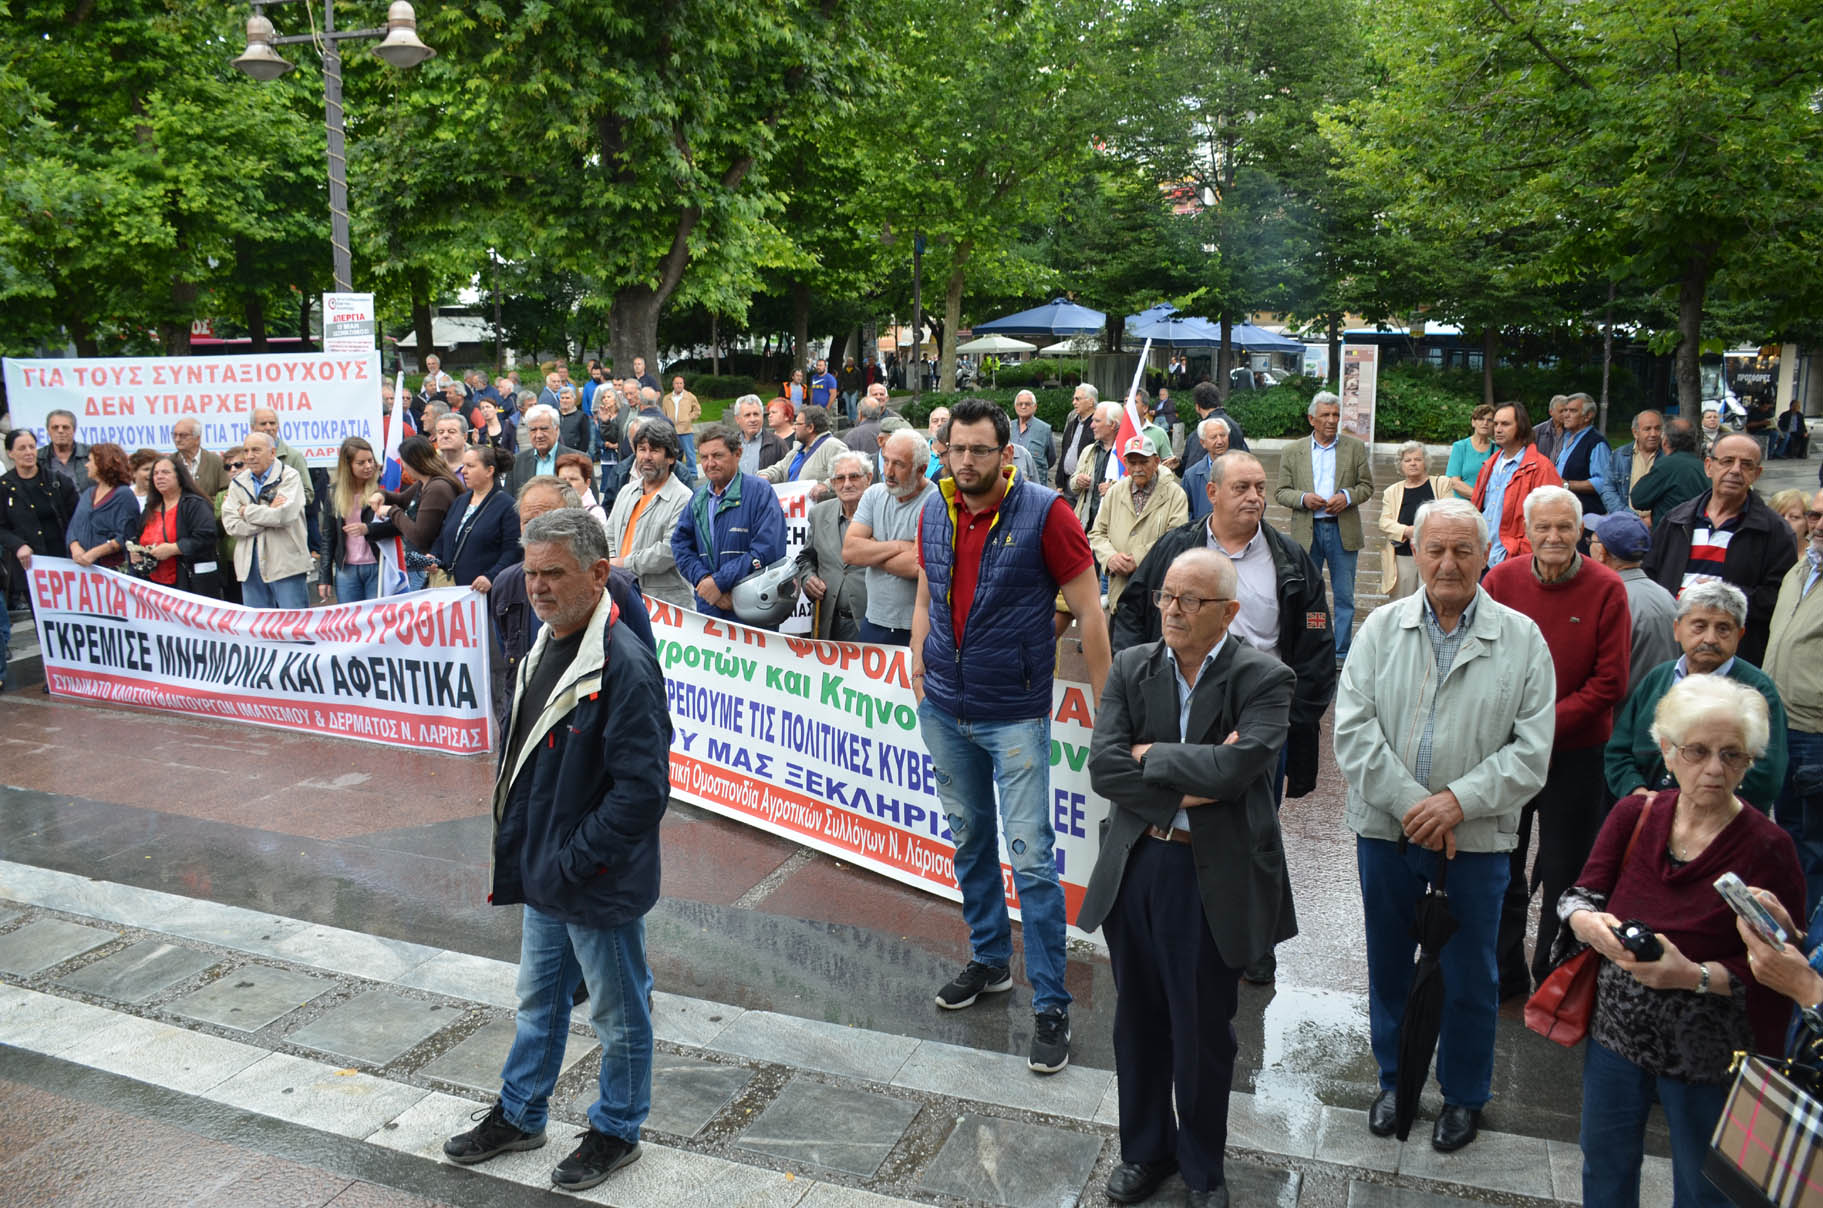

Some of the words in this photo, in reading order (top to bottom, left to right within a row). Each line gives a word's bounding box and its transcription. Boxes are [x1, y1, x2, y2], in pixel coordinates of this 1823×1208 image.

[333, 313, 366, 322] ΑΠΕΡΓΙΑ
[23, 367, 65, 388] ΓΙΑ
[73, 365, 143, 386] ΤΟΥΣ
[152, 360, 369, 385] ΣΥΝΤΑΞΙΟΥΧΟΥΣ
[85, 395, 135, 416] ΔΕΝ
[144, 392, 256, 415] ΥΠΑΡΧΕΙ
[266, 391, 313, 412] ΜΙΑ
[80, 424, 156, 446] ΥΠΑΡΧΟΥΝ
[205, 423, 228, 443] ΓΙΑ
[231, 422, 249, 442] ΤΗ
[34, 569, 128, 617] ΕΡΓΑΤΙΑ
[249, 610, 314, 641] ΤΩΡΑ
[315, 604, 363, 643] ΜΙΑ
[365, 600, 478, 648] ΓΡΟΘΙΑ!
[43, 620, 153, 673] ΓΚΡΕΜΙΣΕ
[156, 634, 278, 690] ΜΝΗΜΟΝΙΑ
[279, 651, 325, 695] ΚΑΙ
[330, 654, 478, 710] ΑΦΕΝΤΙΚΑ
[655, 637, 758, 682] γροτών
[766, 664, 811, 700] και
[820, 671, 917, 731] Κτηνο
[784, 636, 912, 690] ΦΟΡΟΛ
[52, 674, 111, 698] ΣΥΝΔΙΚΑΤΟ
[239, 702, 309, 727] ΙΜΑΤΙΣΜΟΥ
[314, 709, 326, 728] &
[329, 710, 398, 739] ΔΕΡΜΑΤΟΣ
[401, 721, 415, 742] Ν.
[419, 724, 482, 748] ΛΑΡΙΣΑΣ
[664, 677, 744, 734] ΡΕΠΟΥΜΕ
[749, 700, 776, 744] ΤΙΣ
[781, 709, 873, 778] ΠΟΛΙΤΙΚΕΣ
[878, 741, 936, 797] ΚΥΒΕ
[670, 760, 692, 792] τική
[692, 763, 760, 810] Ομοσπονδία
[760, 786, 824, 832] Αγροτικών
[823, 807, 886, 856] Συλλόγων
[888, 829, 902, 861] Ν.
[905, 836, 960, 889] Λάρισας
[707, 737, 774, 779] ΜΑΣ
[785, 761, 953, 842] ΞΕΚΛΗΡΙ
